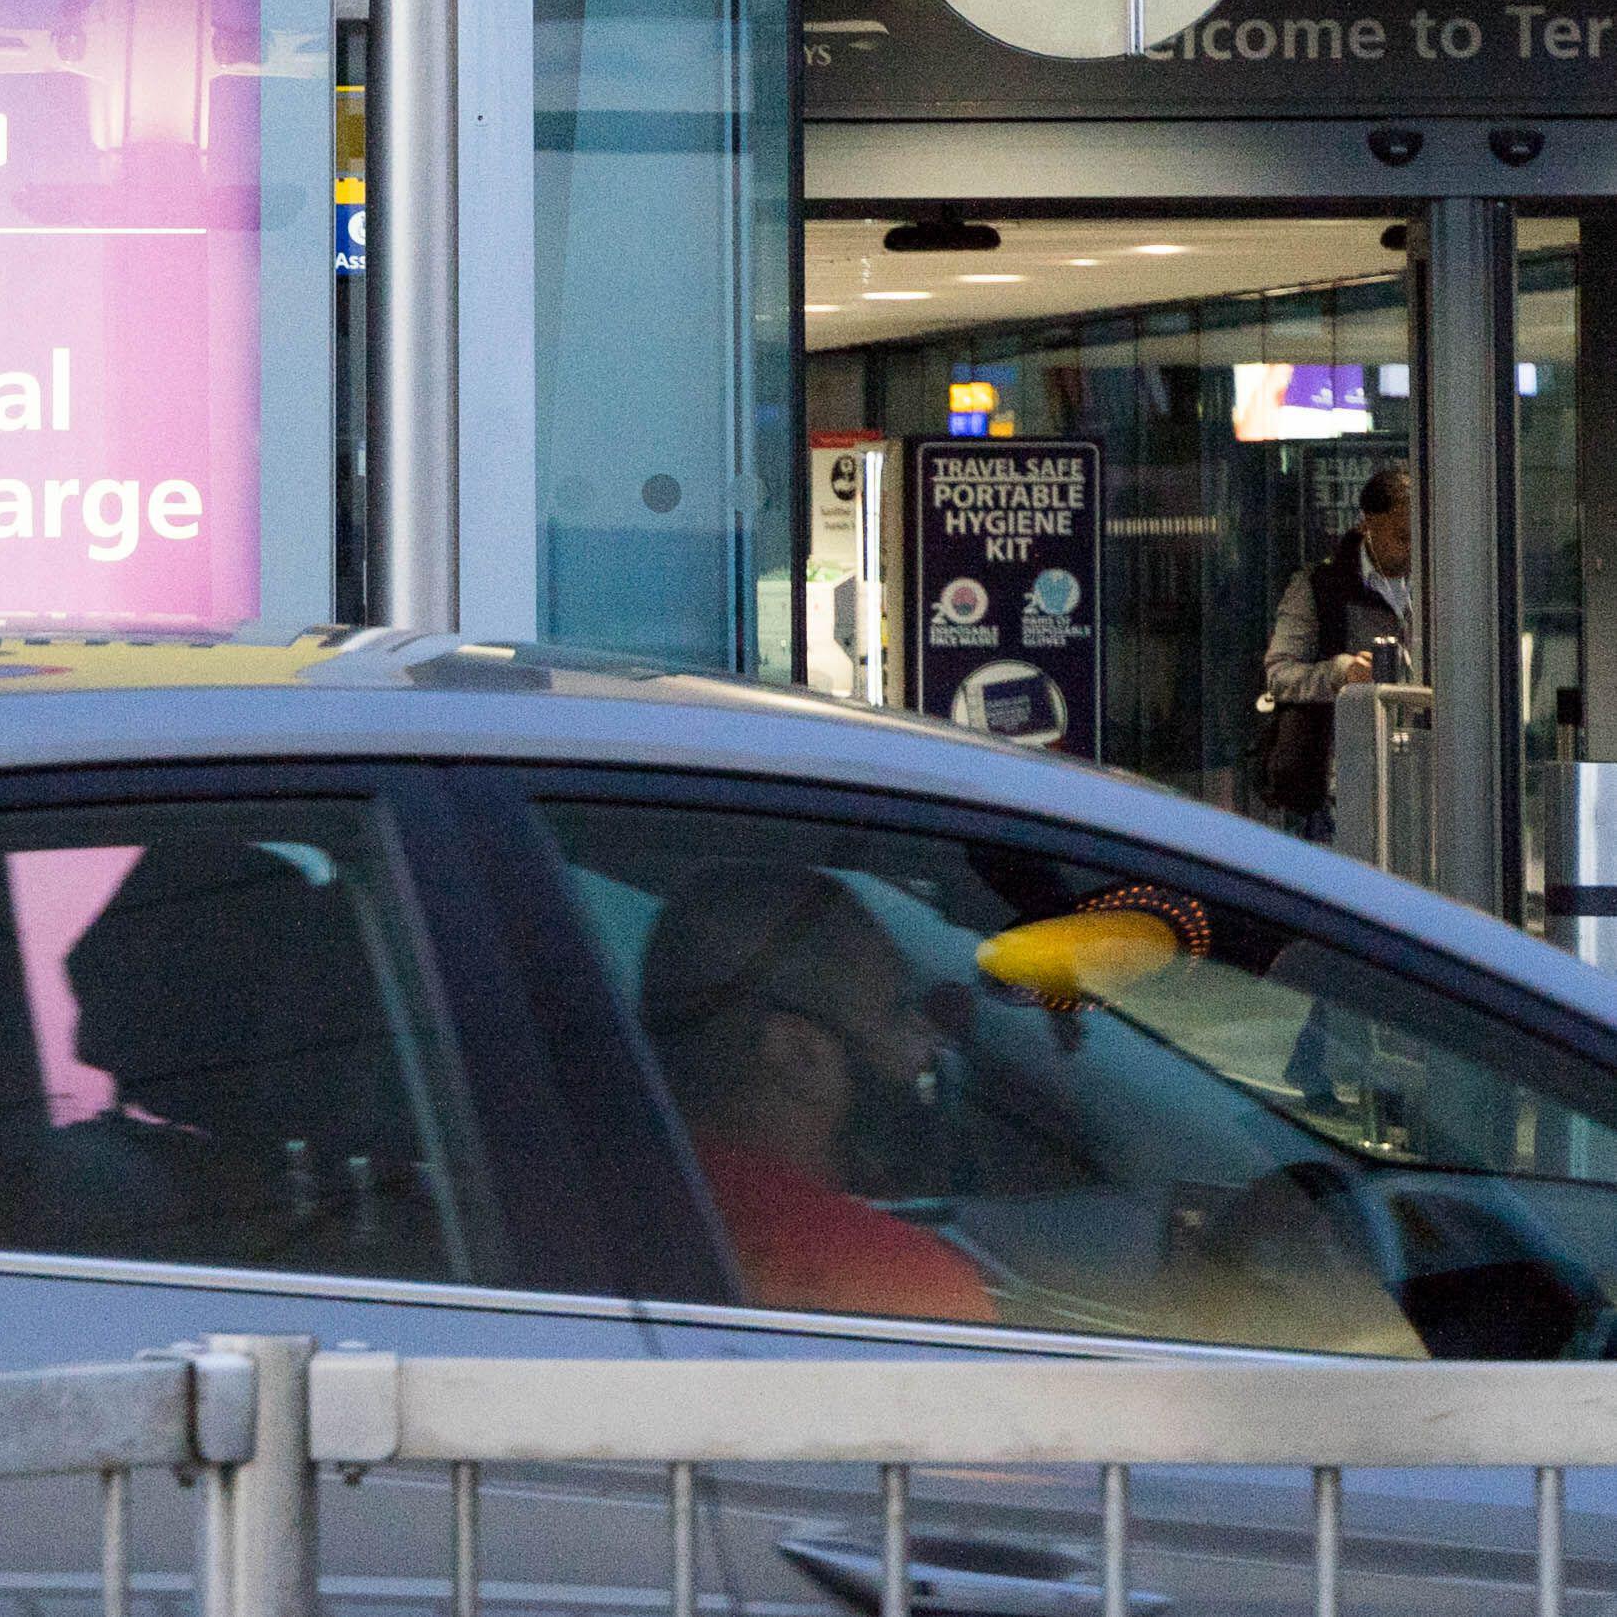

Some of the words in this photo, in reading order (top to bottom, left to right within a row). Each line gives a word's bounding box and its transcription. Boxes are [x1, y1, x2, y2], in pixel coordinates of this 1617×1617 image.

[1410, 9, 1482, 60] to
[933, 458, 1016, 479] TRAVEL
[1027, 458, 1084, 477] SAFE
[933, 485, 1084, 509] PORTABLE
[945, 510, 1073, 535] HYGIENE
[986, 538, 1033, 562] KIT
